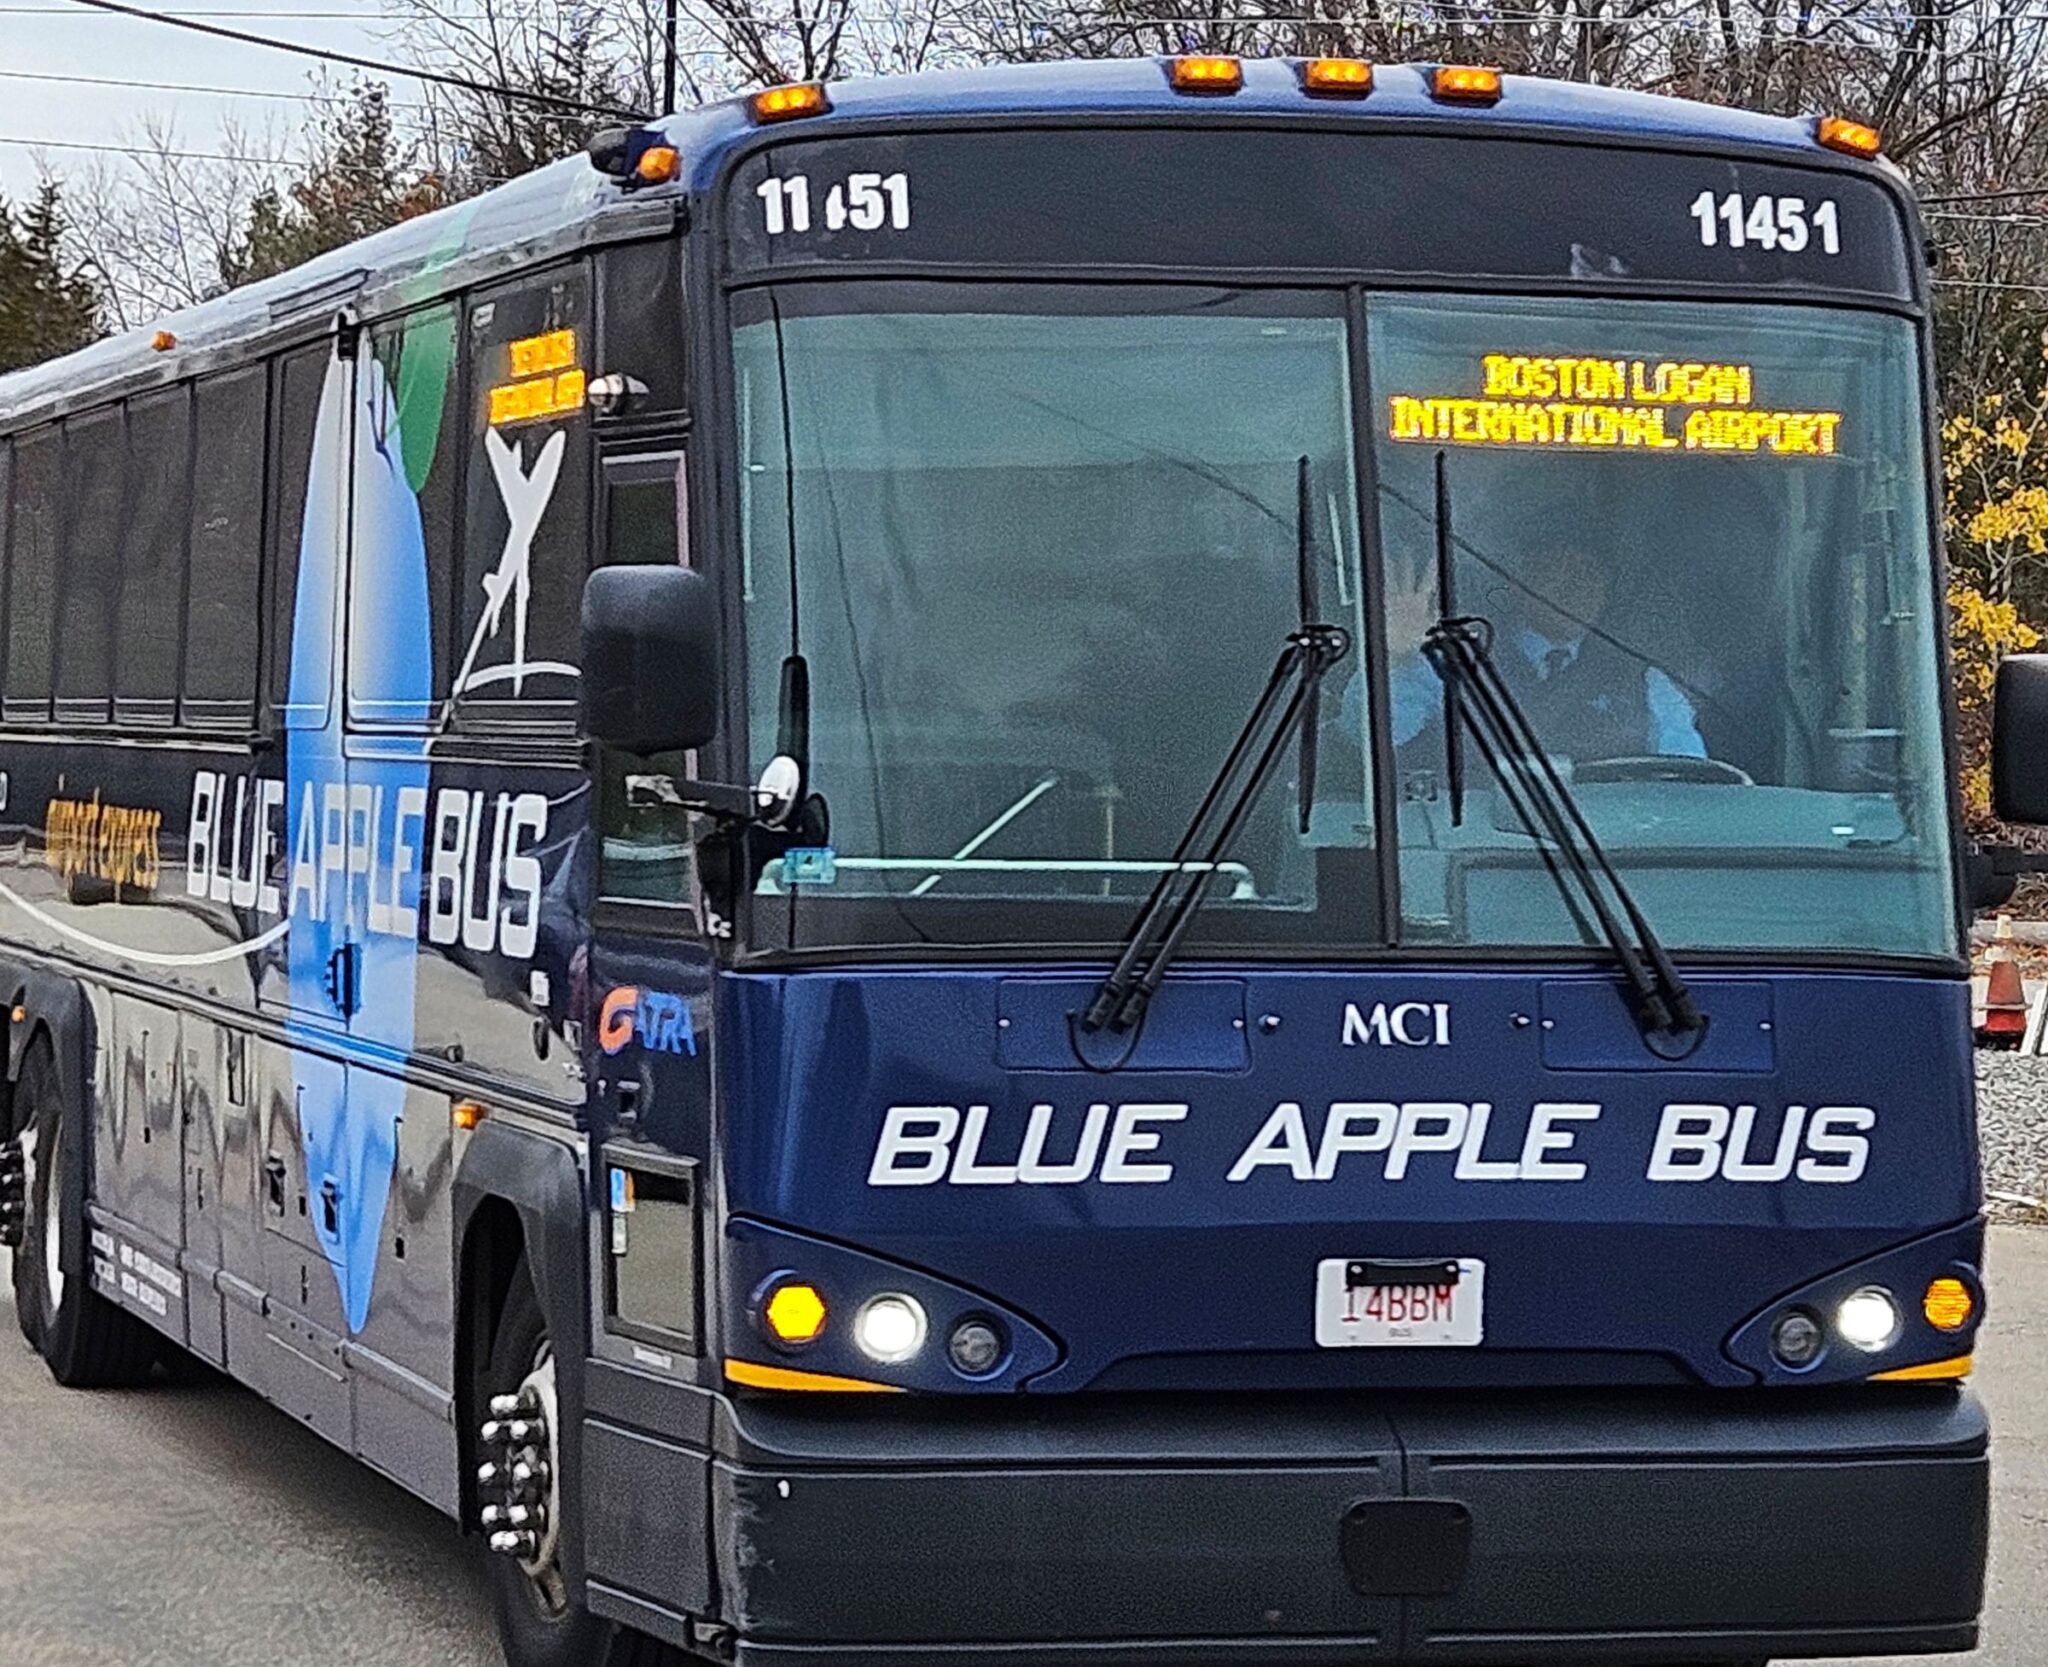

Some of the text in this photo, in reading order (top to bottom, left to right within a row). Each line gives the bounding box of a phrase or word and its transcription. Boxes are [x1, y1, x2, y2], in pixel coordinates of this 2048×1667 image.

[1690, 191, 1840, 254] 11451
[1482, 354, 1752, 404] BOSTON LOGAN
[1390, 396, 1843, 454] INTERNATIONAL AIRPORT
[187, 771, 285, 914] BLUE
[289, 781, 425, 938] APPLE
[428, 788, 548, 958] BUS
[600, 985, 697, 1056] GATRA
[1341, 1003, 1451, 1046] MCI
[867, 1102, 1876, 1186] BLUE APPLE BUS
